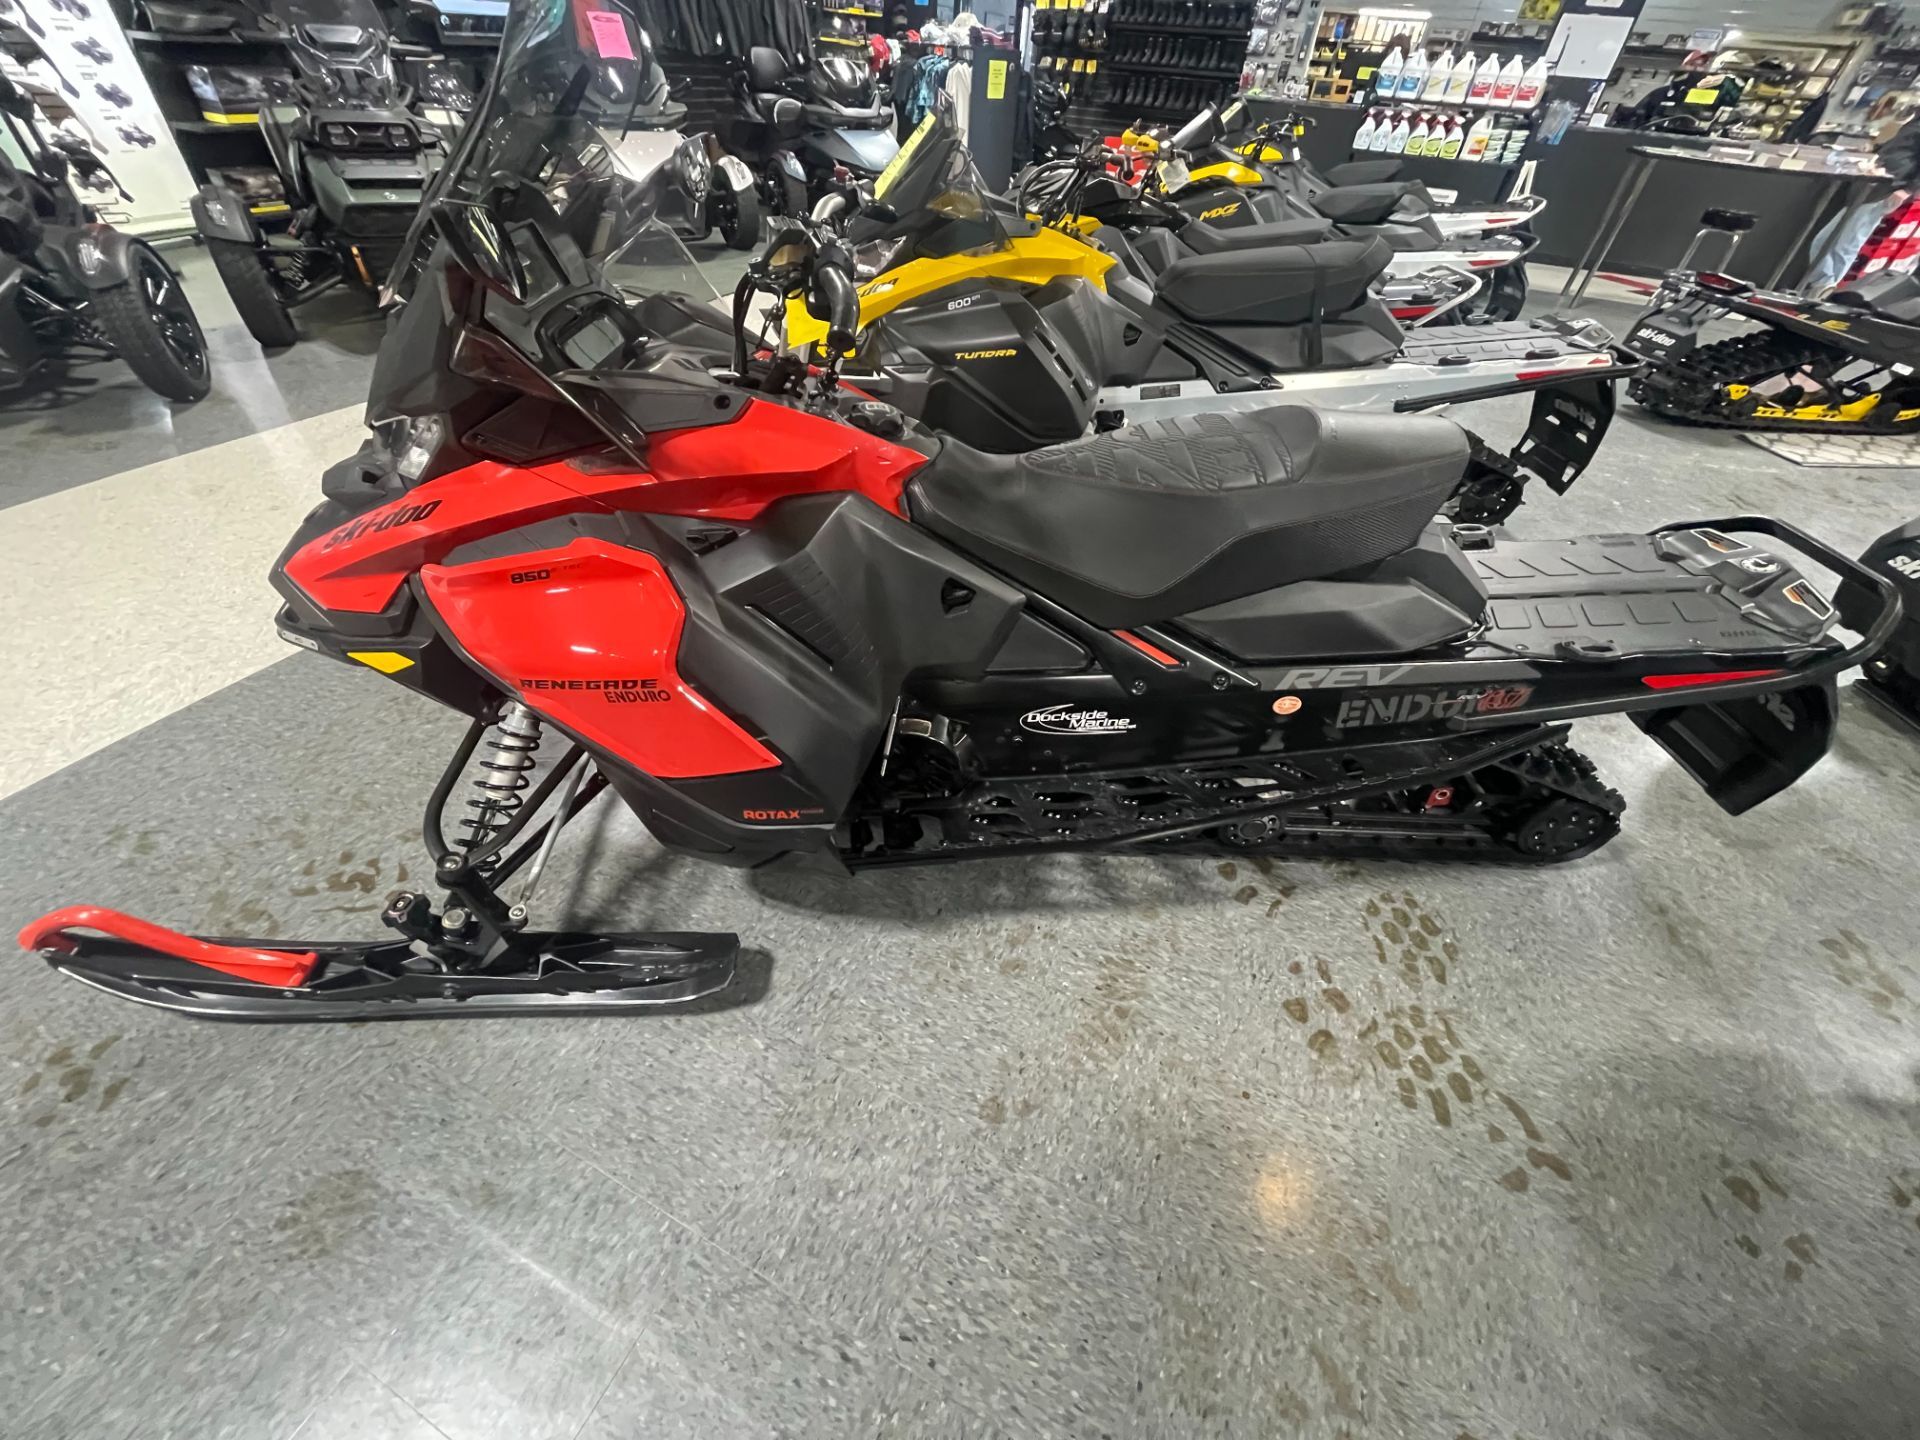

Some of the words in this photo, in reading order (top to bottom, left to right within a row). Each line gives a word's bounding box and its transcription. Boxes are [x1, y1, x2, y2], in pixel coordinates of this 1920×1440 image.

[948, 297, 971, 310] 600
[954, 348, 1017, 361] TUNDRA
[511, 569, 551, 584] 850
[519, 678, 658, 690] RENEGADE
[1275, 665, 1415, 691] REV
[603, 689, 672, 704] ENDURO
[1027, 710, 1108, 722] Dockside
[1068, 717, 1131, 729] Marine
[743, 808, 800, 820] ROTAX
